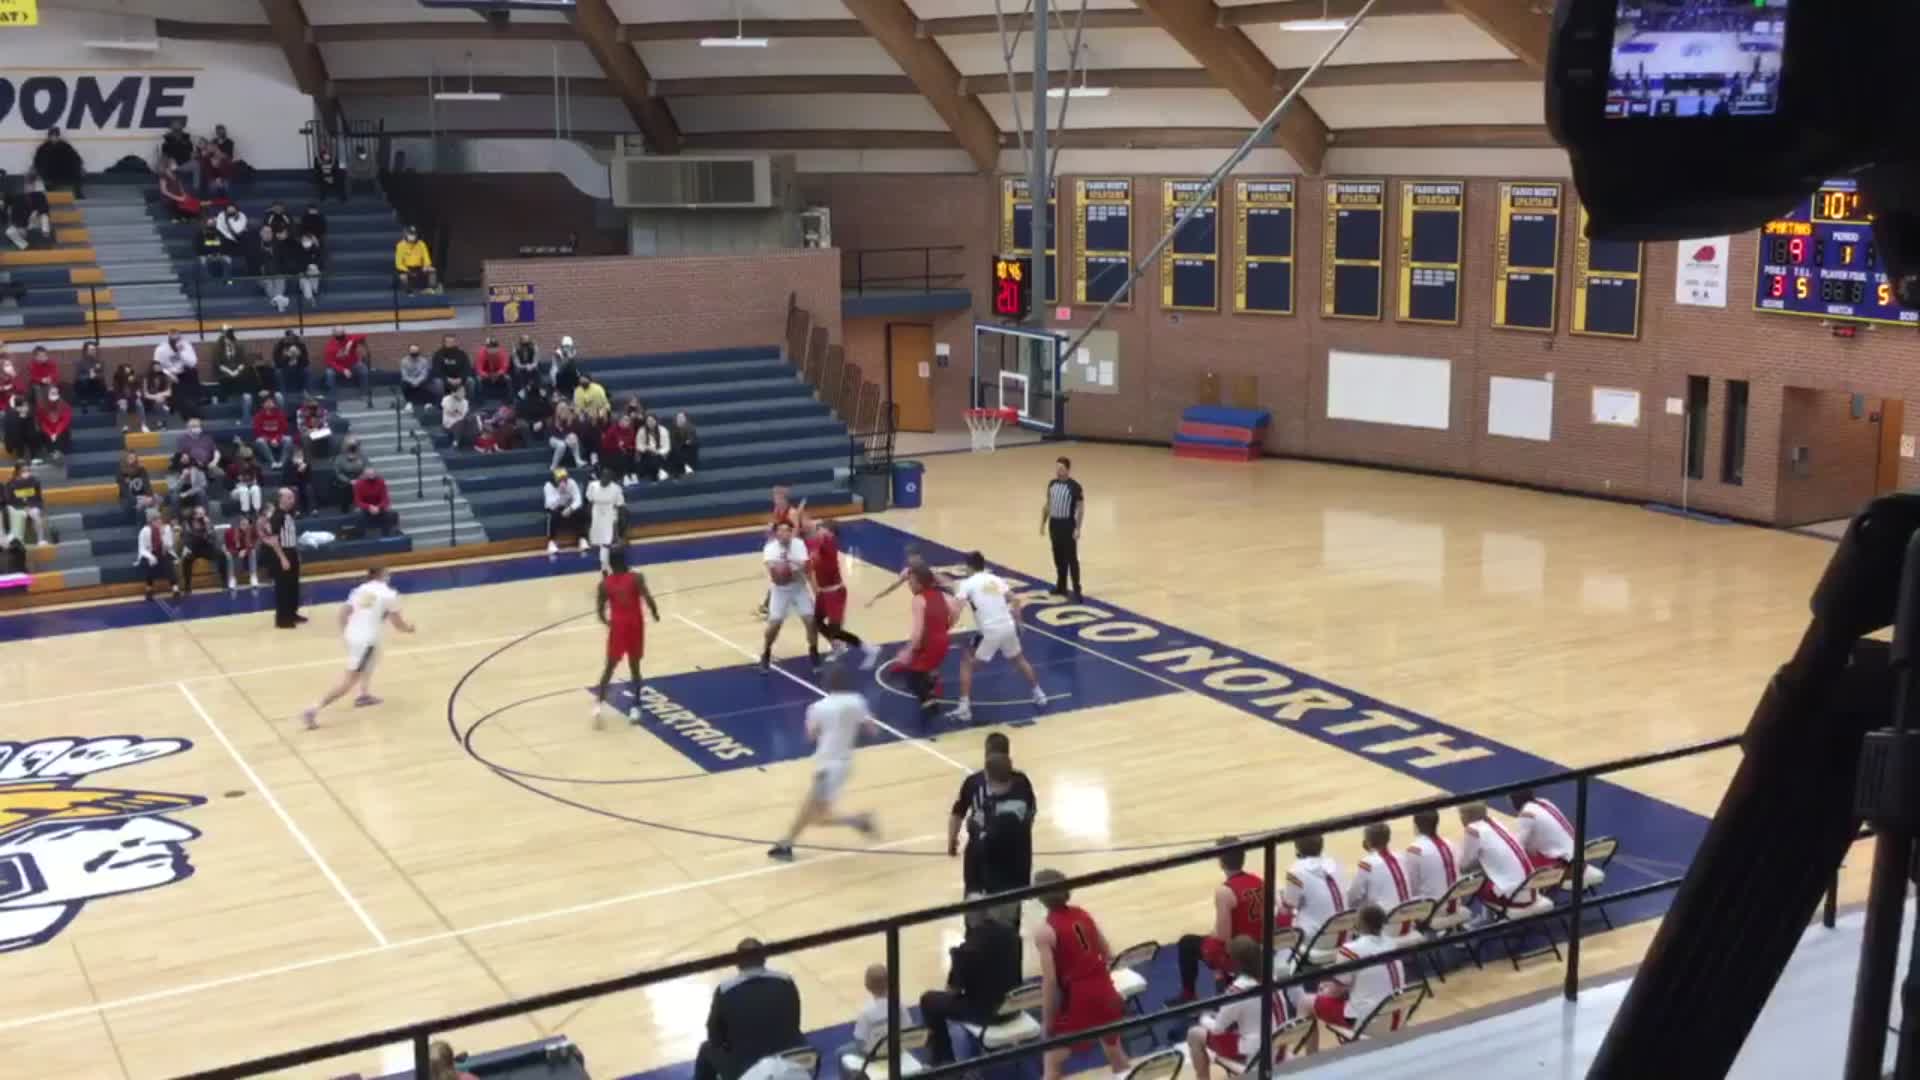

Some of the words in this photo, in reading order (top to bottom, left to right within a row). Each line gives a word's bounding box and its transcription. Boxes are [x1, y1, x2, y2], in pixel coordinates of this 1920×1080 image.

[1790, 239, 1803, 262] 9
[1772, 276, 1782, 296] 3
[1796, 277, 1807, 299] 5
[1877, 284, 1890, 306] 5
[1137, 646, 1495, 769] NORTH
